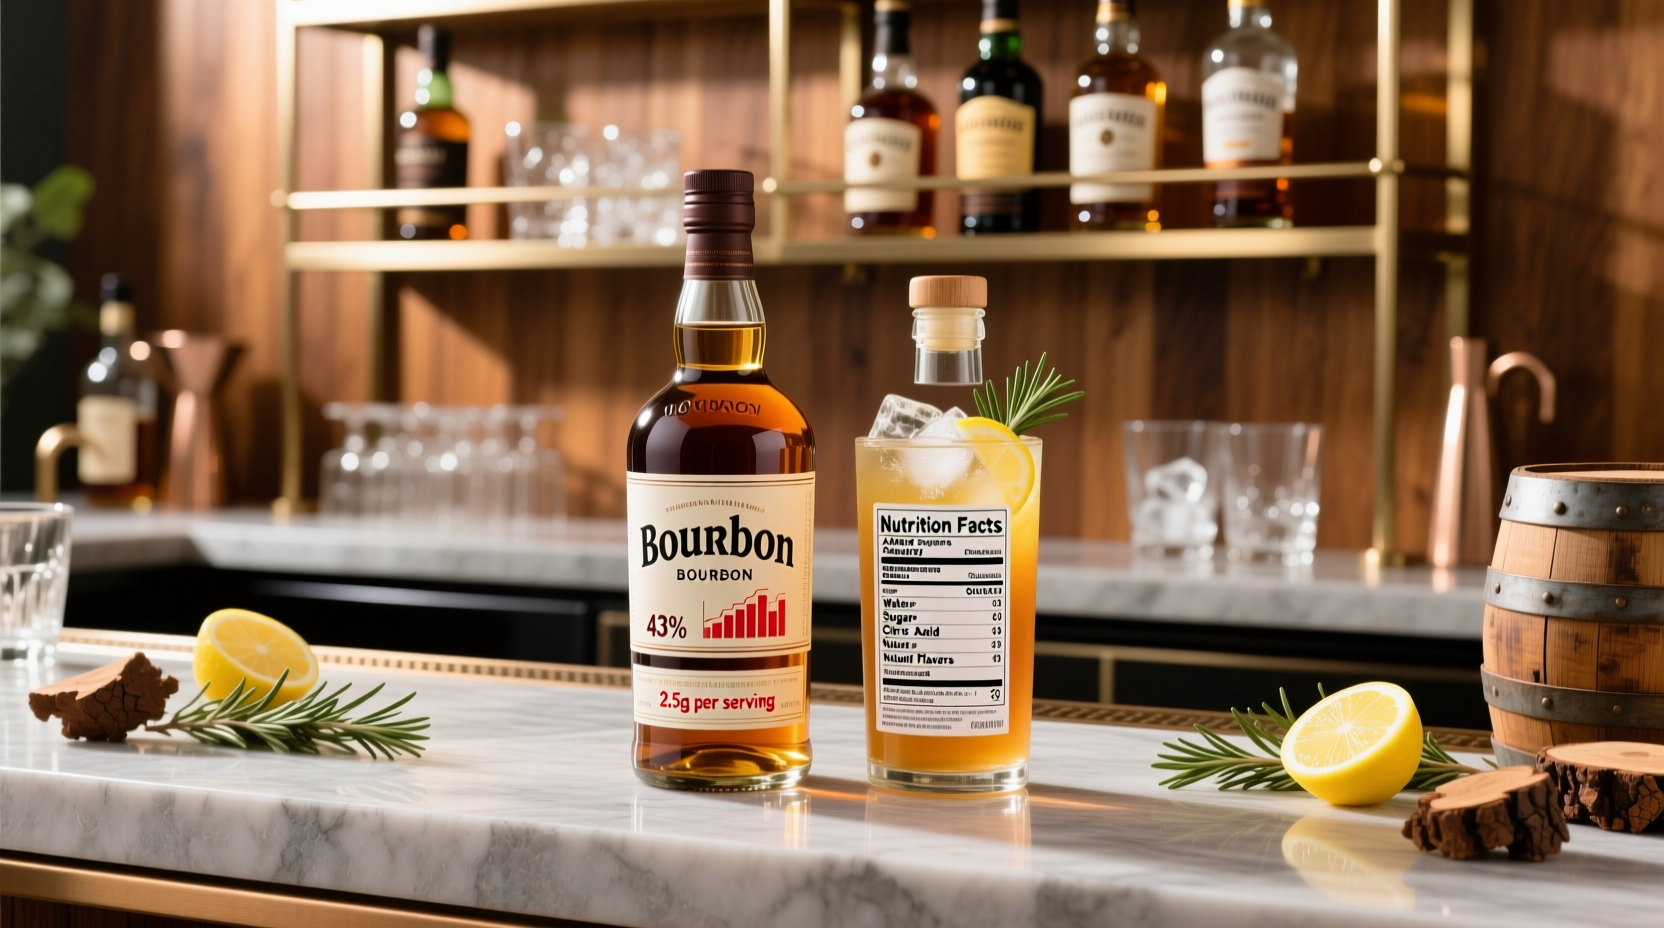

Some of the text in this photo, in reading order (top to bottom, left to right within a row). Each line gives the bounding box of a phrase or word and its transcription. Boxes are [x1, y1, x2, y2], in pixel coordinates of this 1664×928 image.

[881, 515, 1003, 534] Nutrition Facts
[640, 514, 794, 568] Bourbon
[676, 569, 752, 581] BOURBON
[646, 613, 687, 639] 43%
[660, 690, 775, 713] 2.5g per serving
